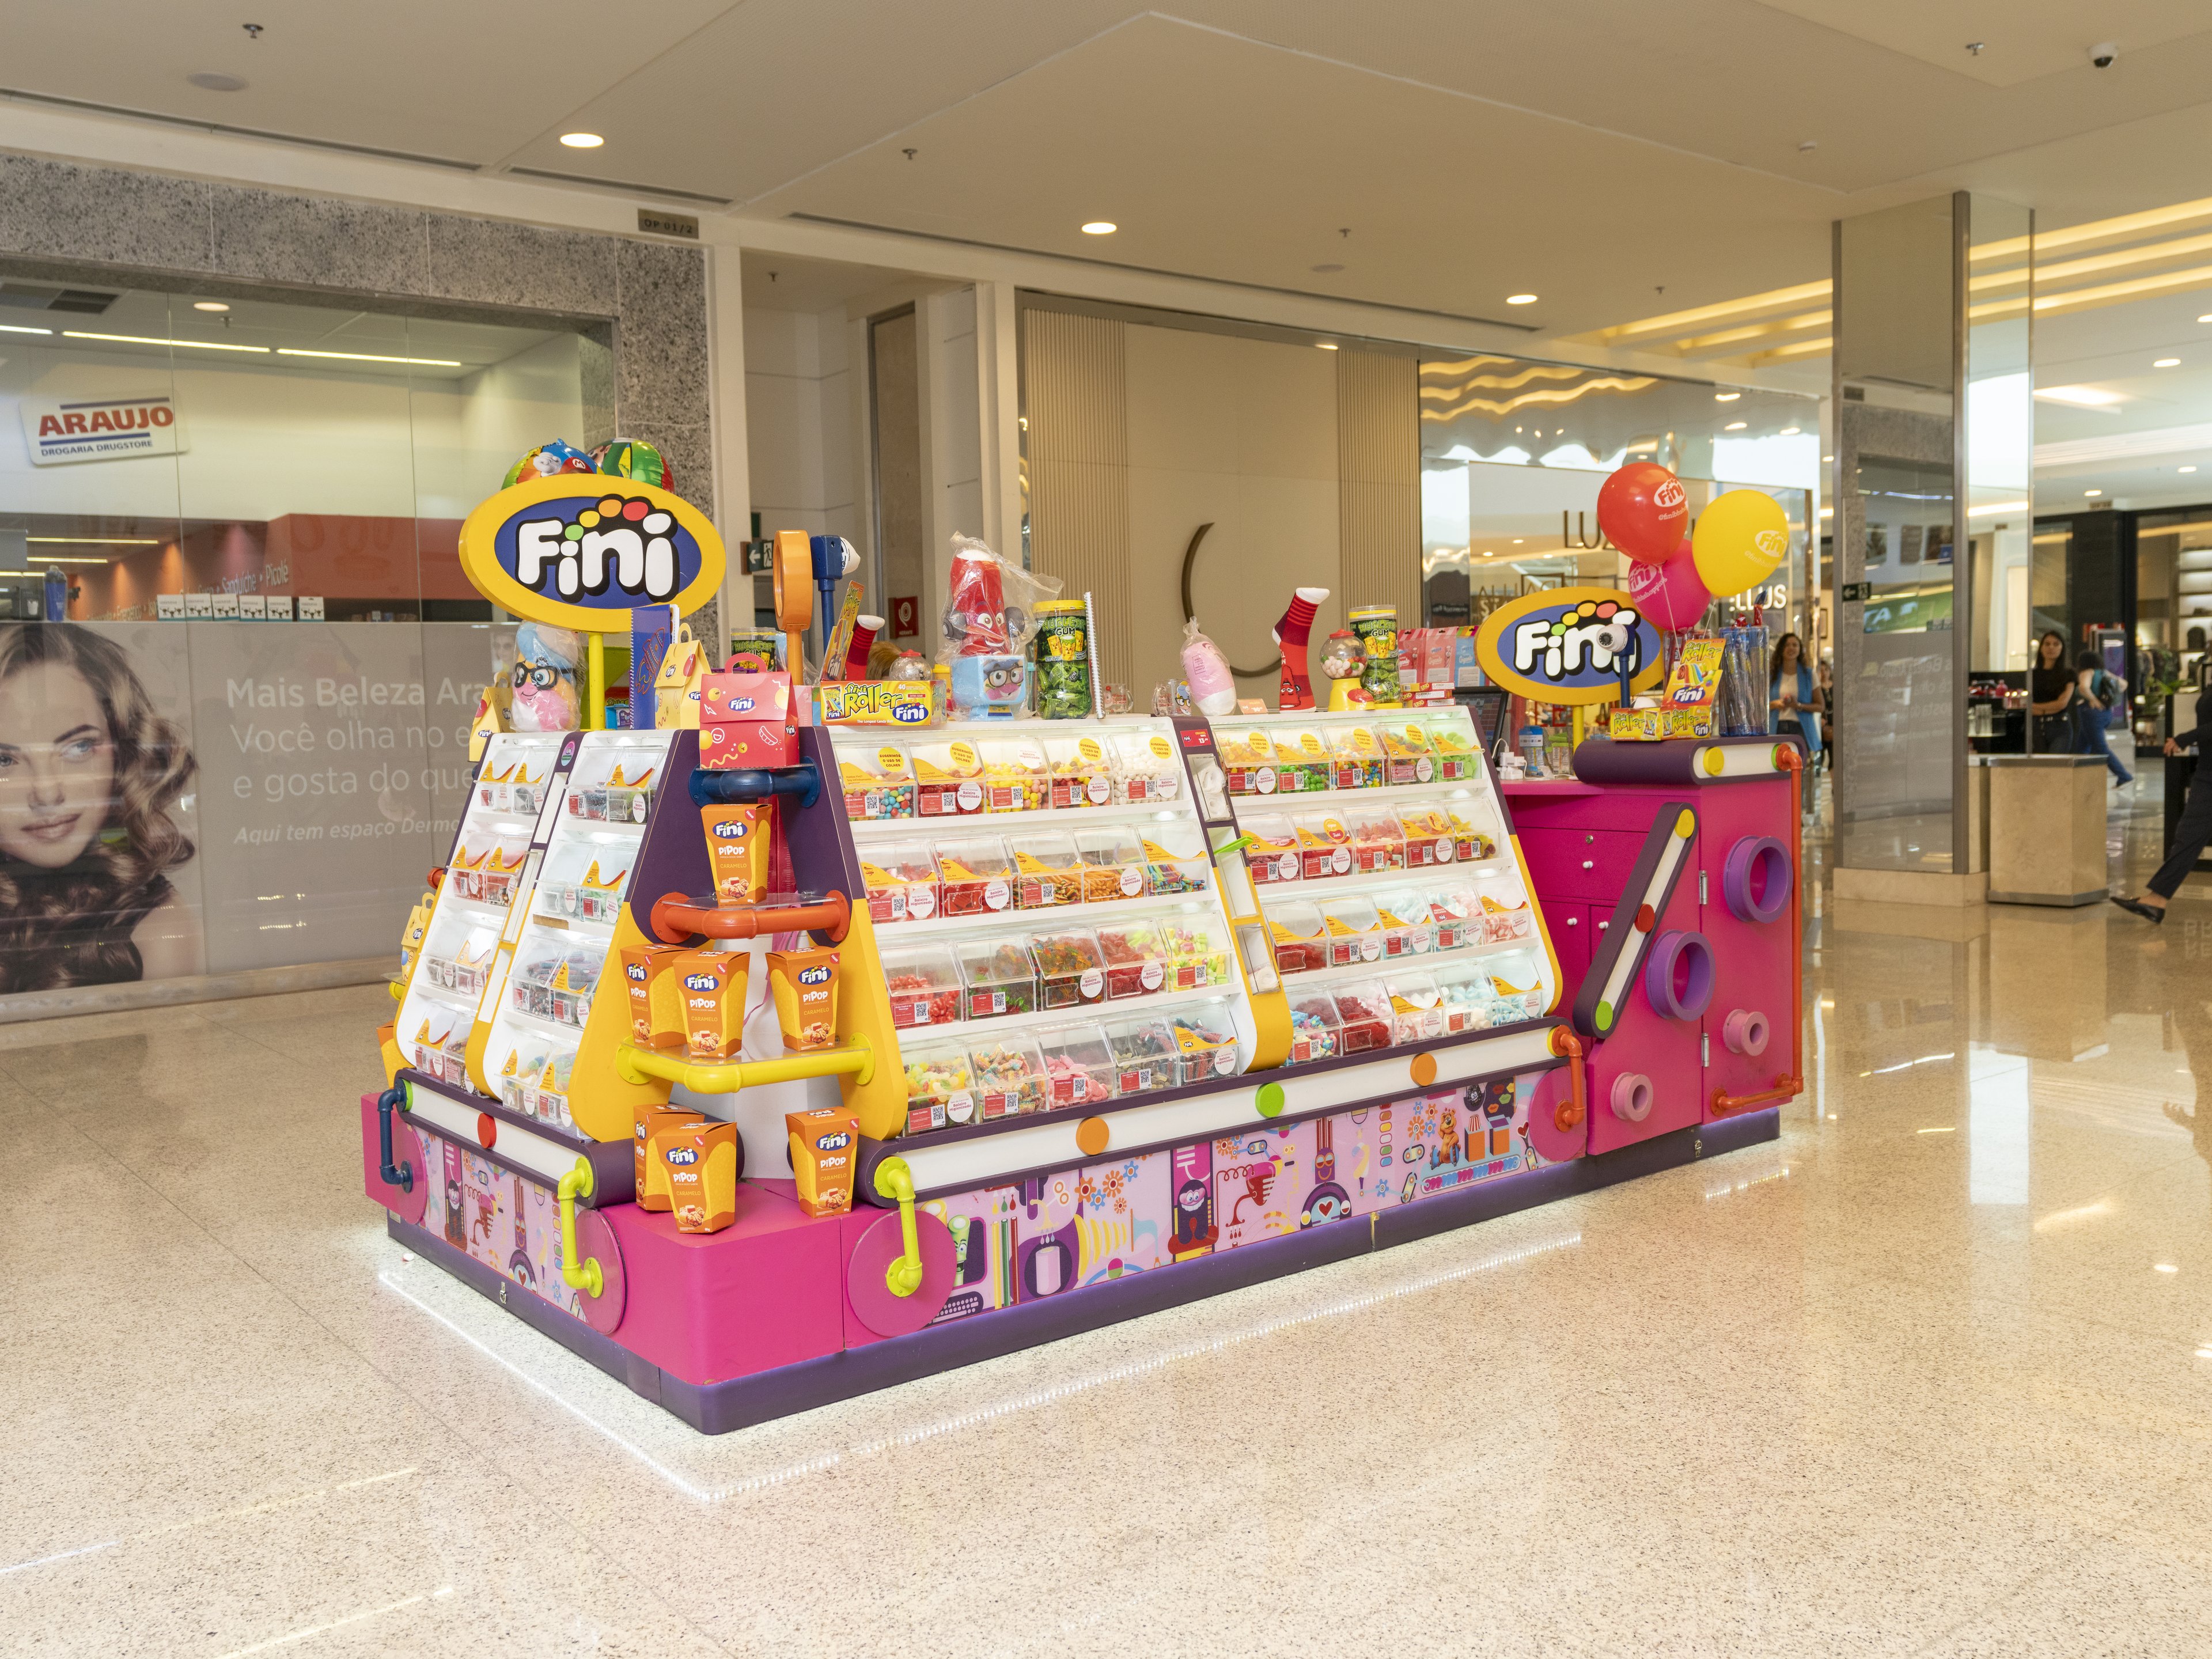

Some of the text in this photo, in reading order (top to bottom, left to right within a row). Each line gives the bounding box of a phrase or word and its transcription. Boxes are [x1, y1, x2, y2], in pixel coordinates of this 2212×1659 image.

[39, 407, 174, 437] ARAUJO
[41, 440, 153, 456] DROGARIA DRUGSTORE
[1657, 482, 1684, 506] Fini
[518, 512, 675, 597] Fini
[1041, 616, 1085, 631] NUCLEAR
[1055, 627, 1075, 636] GUM
[1515, 609, 1637, 679] Fini
[1680, 642, 1722, 664] Roller
[226, 677, 305, 709] Mais
[316, 676, 425, 707] Beleza
[691, 692, 701, 700] Fin
[1674, 685, 1704, 702] Fini
[730, 697, 752, 711] Fini
[844, 684, 903, 718] Roller
[895, 703, 925, 721] Fini
[1613, 711, 1645, 736] Roller
[1672, 710, 1699, 734] Roller
[230, 722, 315, 753] Você
[327, 720, 394, 750] olha
[407, 724, 444, 748] no
[1694, 724, 1709, 736] Fini
[952, 747, 974, 755] SUGERIMOS
[233, 775, 252, 798] e
[265, 767, 358, 802] gosta
[369, 762, 410, 793] do
[234, 825, 281, 846] Aqui
[287, 825, 323, 840] tem
[329, 821, 395, 840] espaço
[716, 822, 743, 837] Fini
[718, 845, 745, 855] PiPop
[628, 965, 645, 980] Fini
[801, 966, 828, 983] Fini
[688, 975, 715, 990] Fini
[690, 998, 716, 1009] PiPop
[802, 991, 828, 1003] PiPop
[804, 1007, 830, 1016] CARAMELO
[949, 1104, 972, 1112] Higienizado
[819, 1132, 846, 1150] Fini
[669, 1149, 695, 1164] Fini
[820, 1157, 847, 1169] PiPop
[673, 1172, 698, 1183] PiPop
[820, 1173, 847, 1181] CARAMELO
